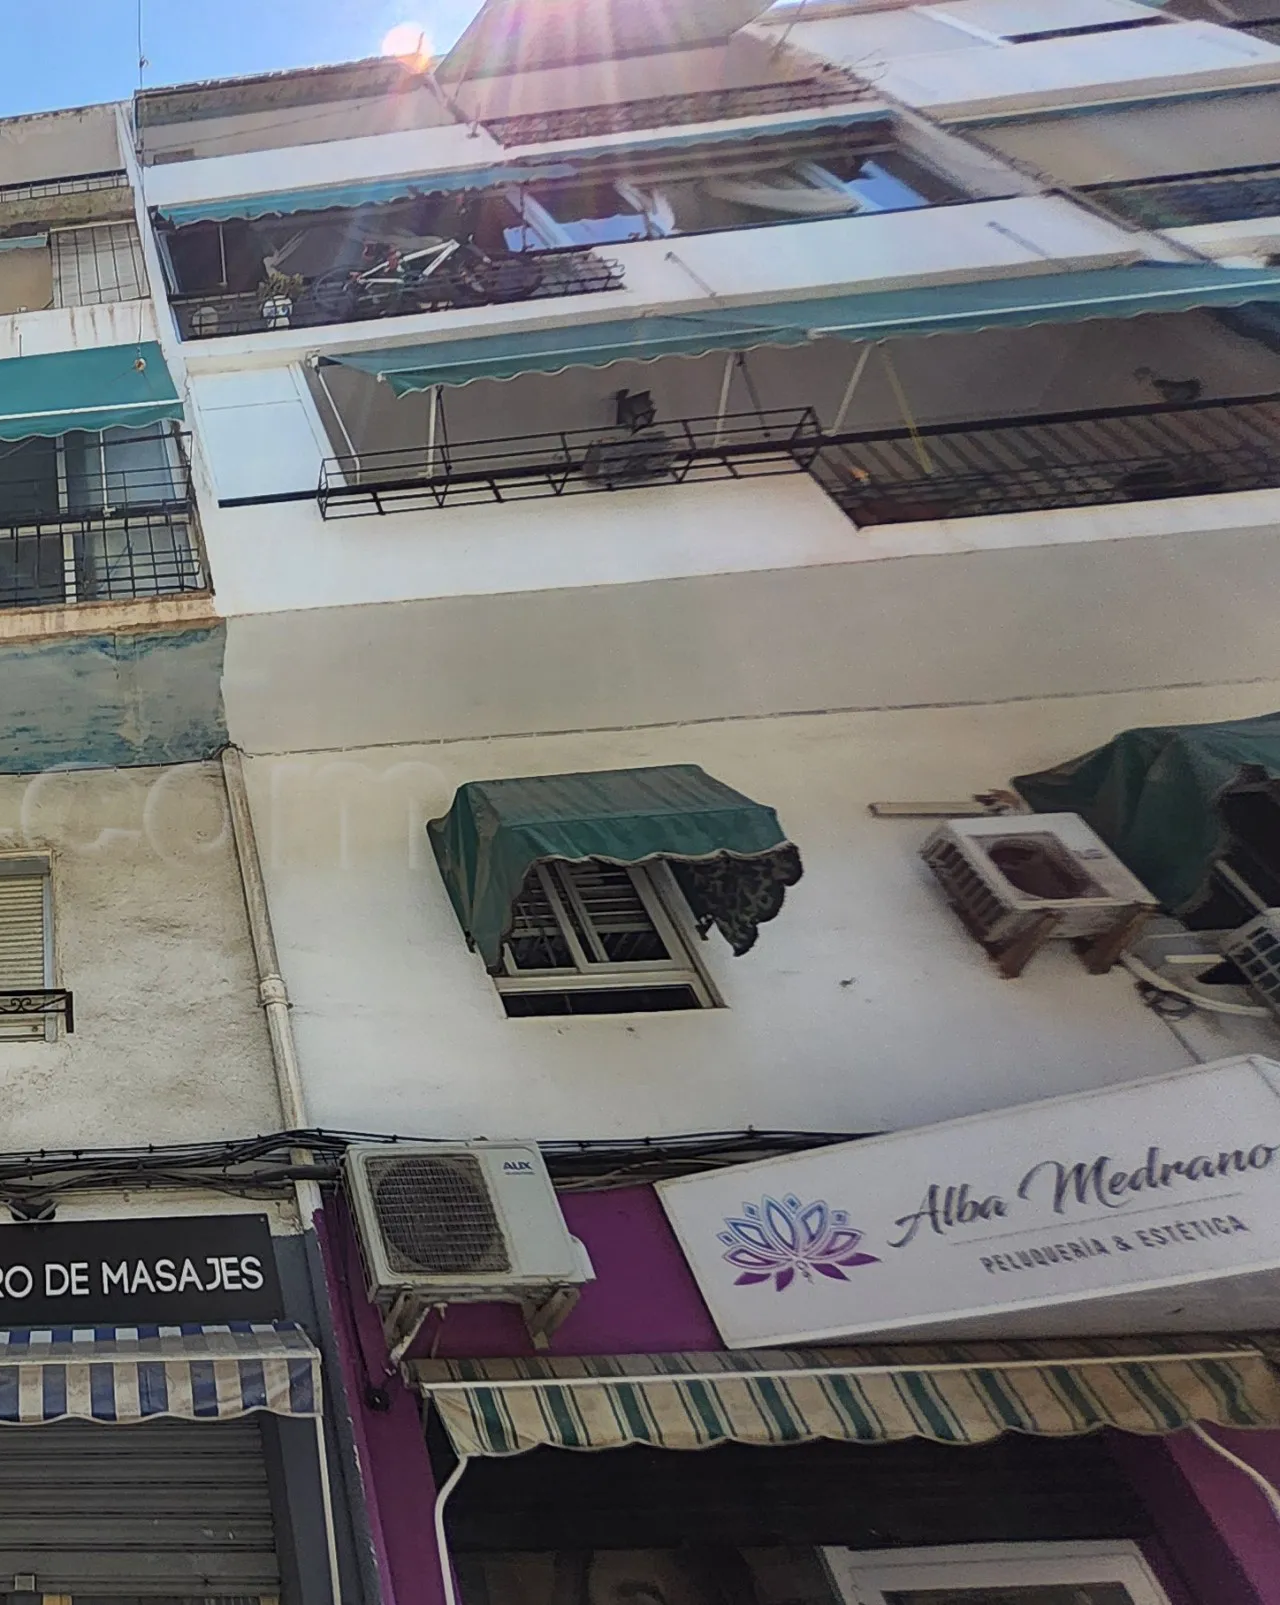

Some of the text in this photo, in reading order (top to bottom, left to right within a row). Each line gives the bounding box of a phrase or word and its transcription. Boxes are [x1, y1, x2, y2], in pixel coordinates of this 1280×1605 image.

[503, 1161, 533, 1170] AUX
[886, 1143, 1280, 1248] Alba Medrano
[979, 1214, 1251, 1275] PELUQUERÍA & ESTÉTICA
[45, 1261, 90, 1297] DE
[101, 1255, 265, 1296] MASAJES
